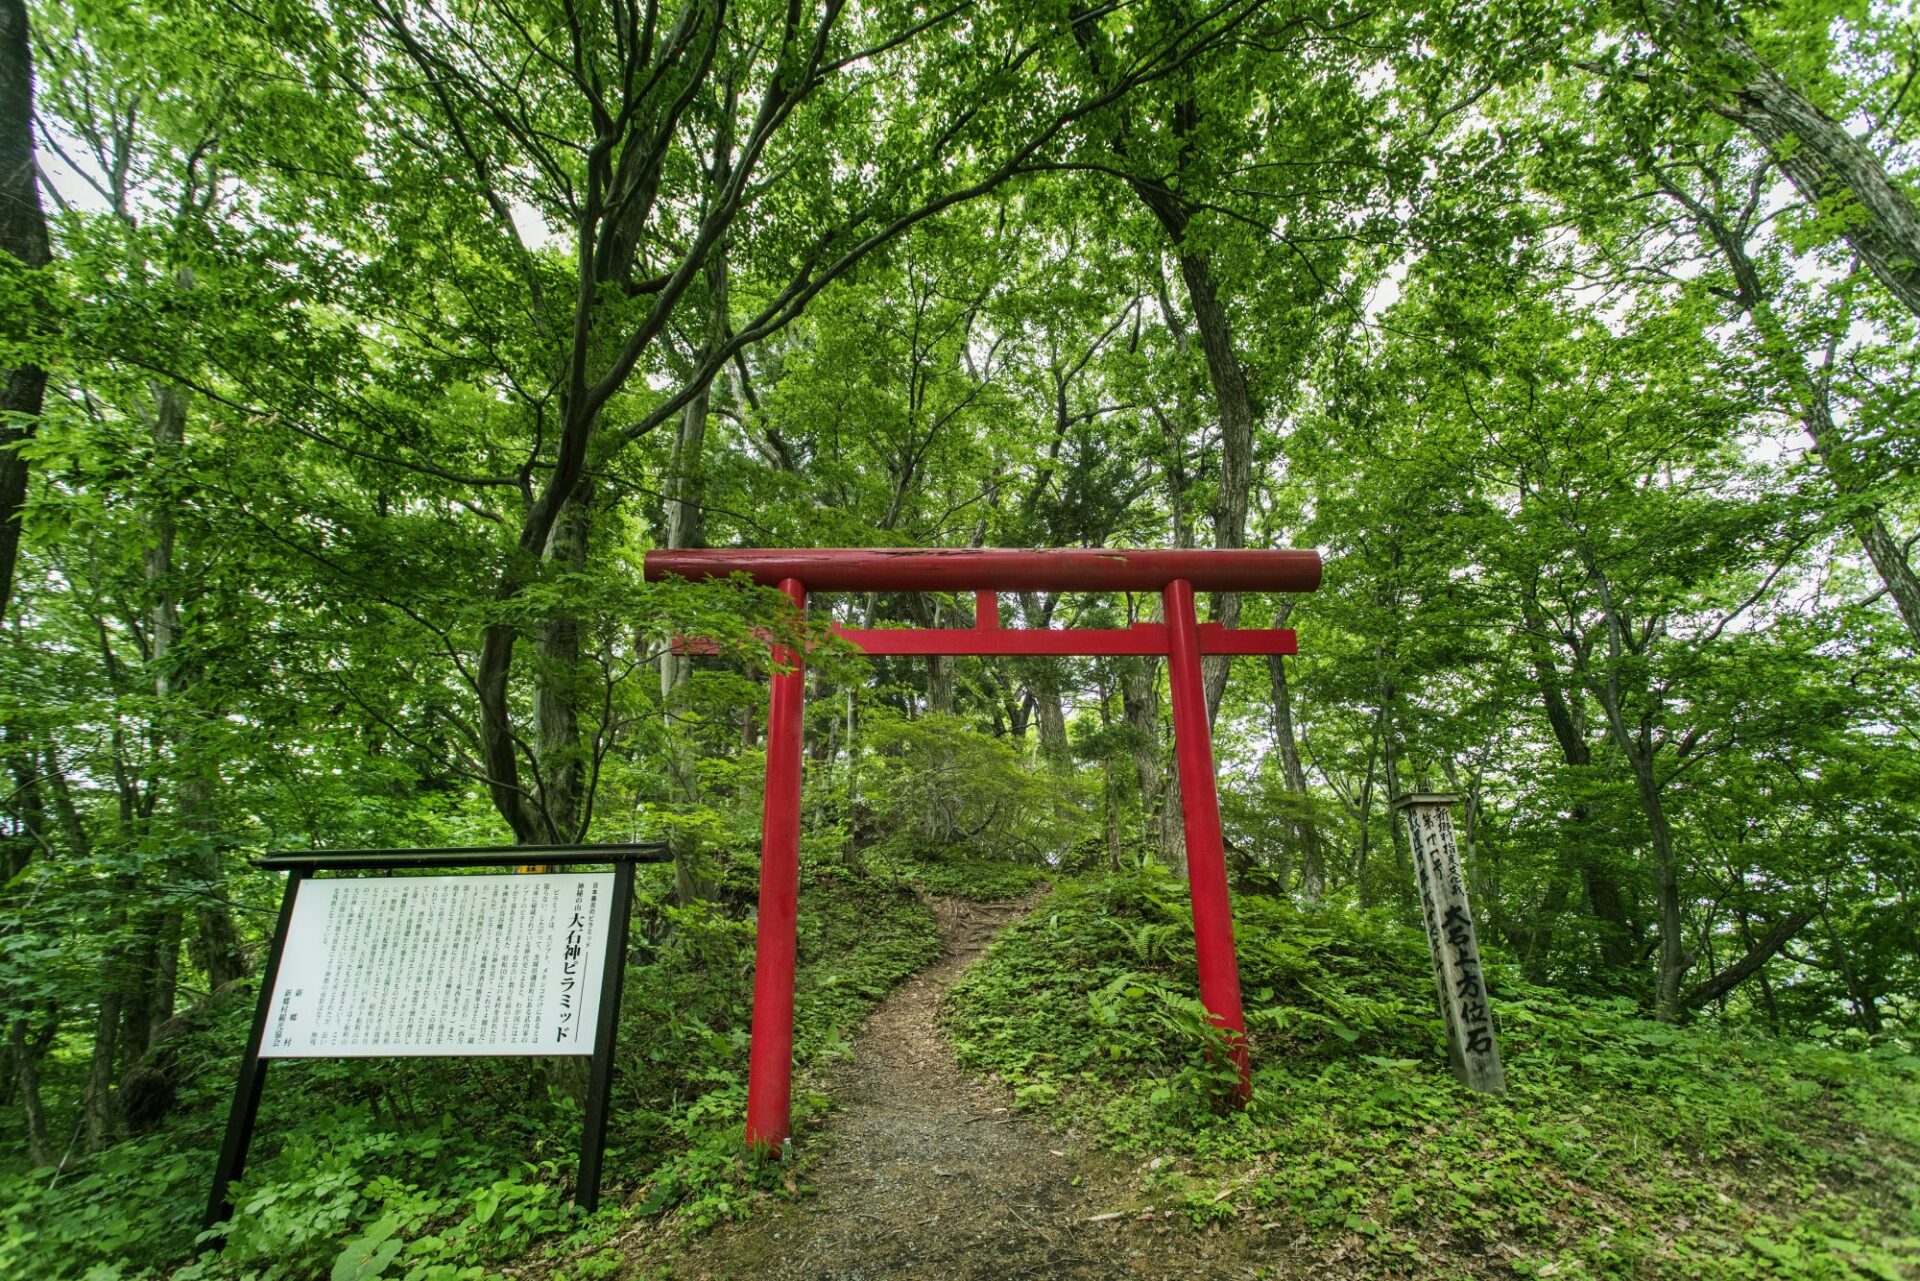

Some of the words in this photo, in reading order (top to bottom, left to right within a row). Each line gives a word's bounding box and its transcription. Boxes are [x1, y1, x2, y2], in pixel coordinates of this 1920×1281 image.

[556, 912, 586, 1043] 大石神ピラミッド
